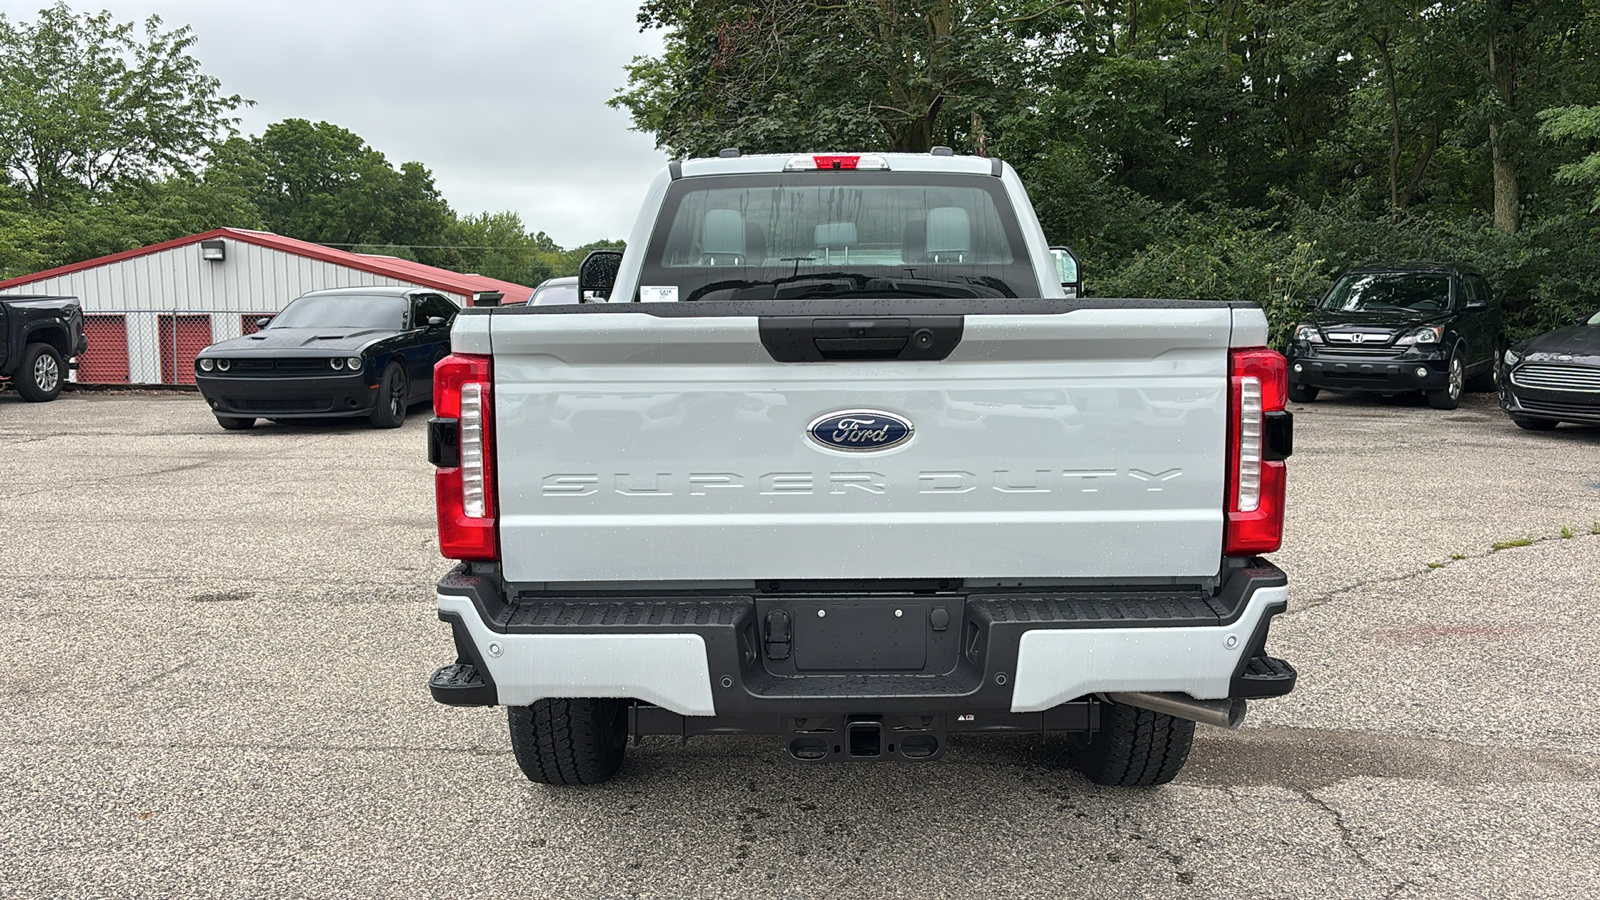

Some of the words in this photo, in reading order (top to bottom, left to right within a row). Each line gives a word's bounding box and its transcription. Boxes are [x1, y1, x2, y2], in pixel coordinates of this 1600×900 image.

[832, 418, 888, 443] Ford
[542, 471, 886, 496] SUPER
[919, 468, 1183, 493] DUTY
